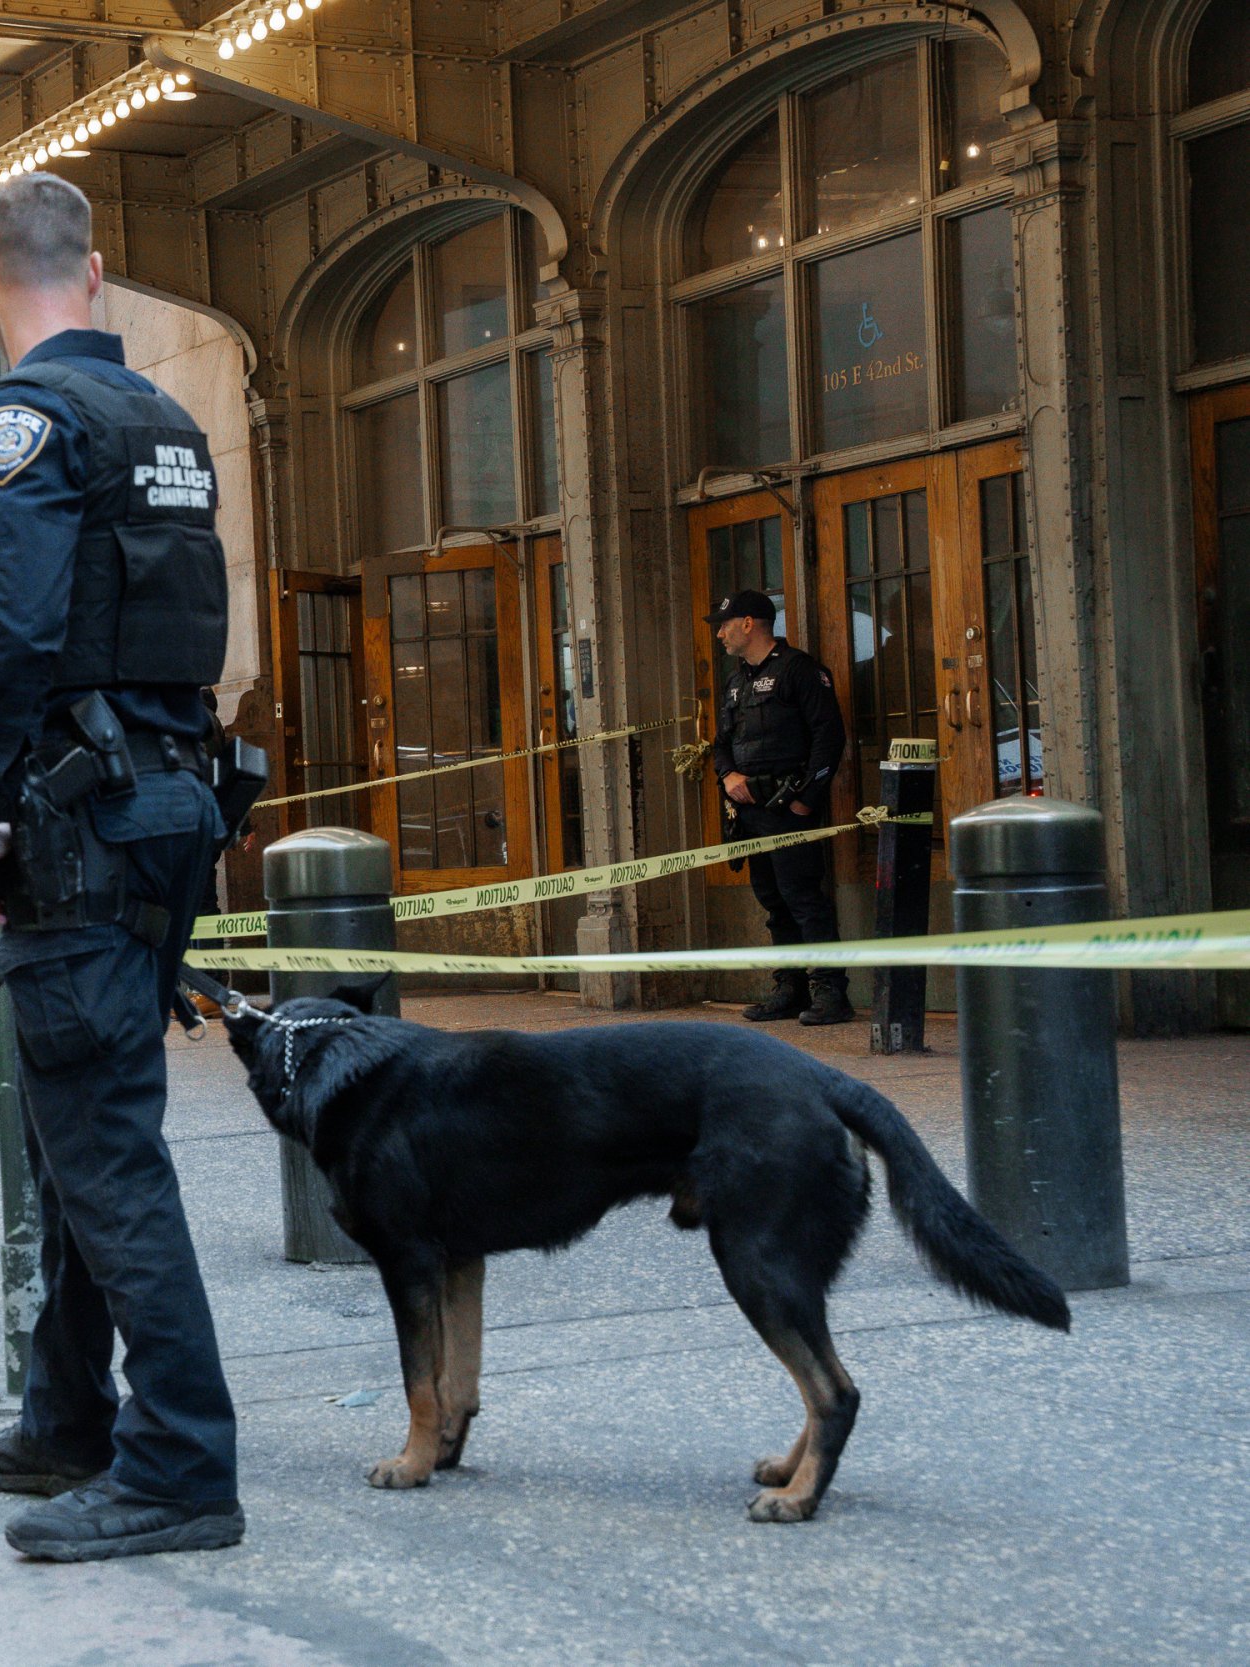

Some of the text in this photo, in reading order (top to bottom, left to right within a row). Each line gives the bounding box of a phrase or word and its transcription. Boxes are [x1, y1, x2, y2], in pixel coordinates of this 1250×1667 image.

[823, 351, 924, 393] 105 E 42nd St.
[155, 444, 197, 469] MTA
[133, 465, 213, 491] POLICE
[753, 679, 775, 688] POLICE
